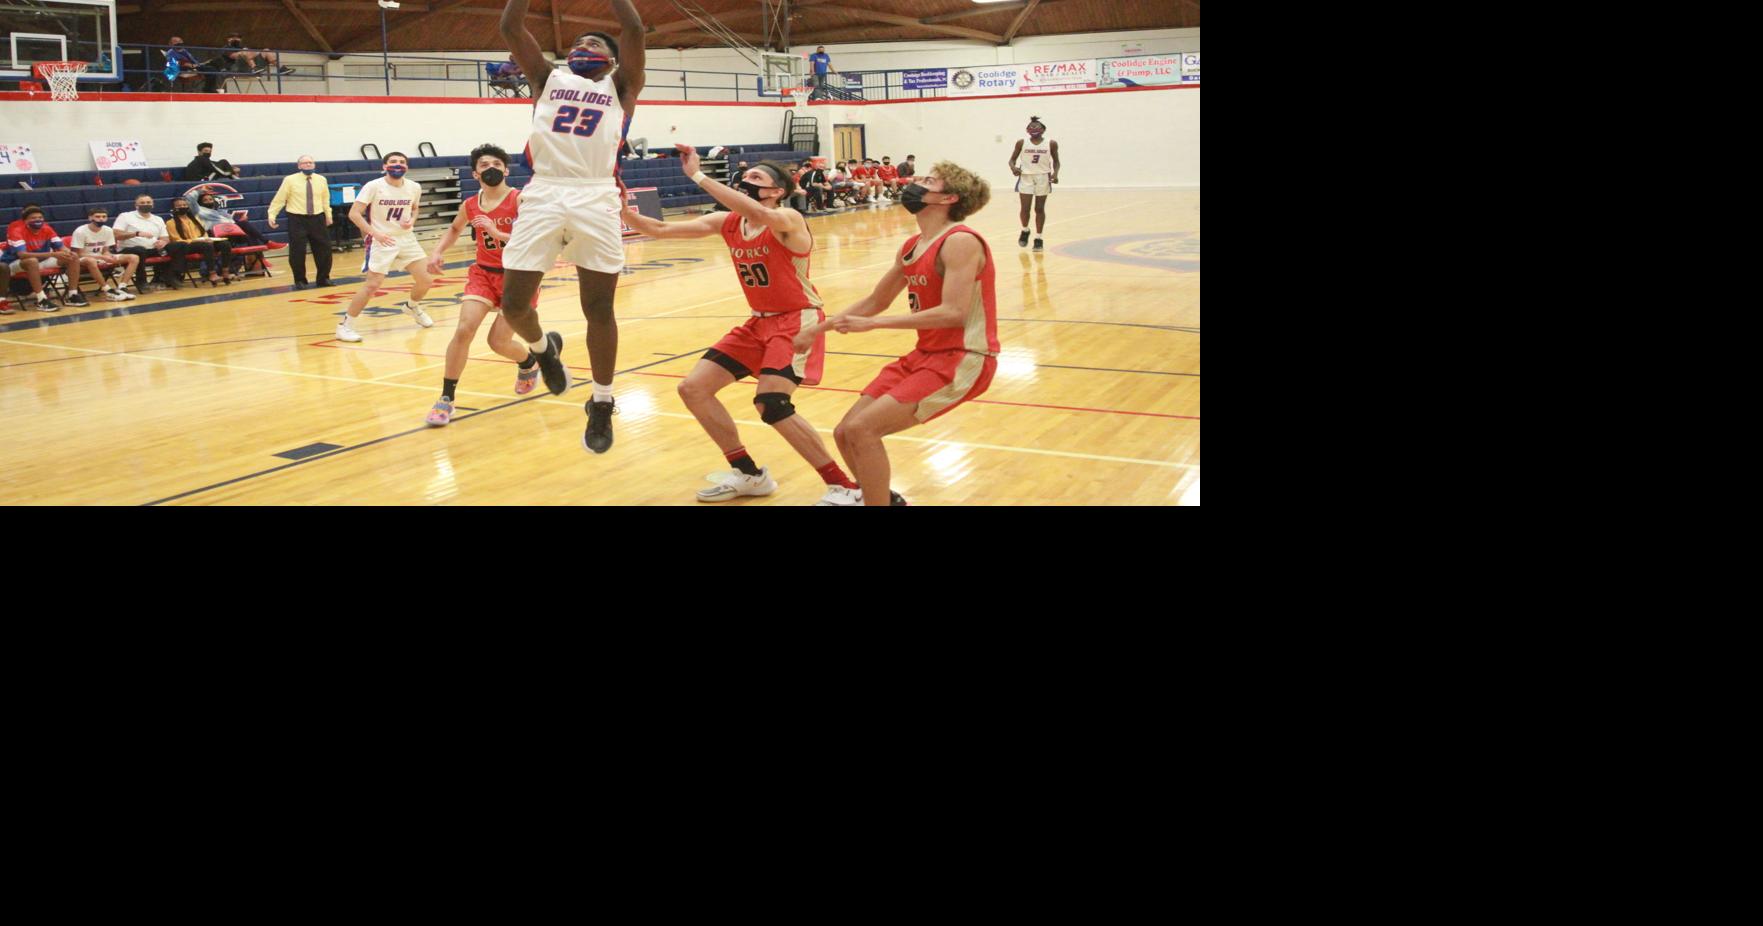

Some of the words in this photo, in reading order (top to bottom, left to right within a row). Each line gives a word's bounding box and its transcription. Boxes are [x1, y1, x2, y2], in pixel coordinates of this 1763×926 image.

[1034, 63, 1086, 74] RE/MAX
[1111, 60, 1146, 68] Coolidge
[1148, 57, 1177, 66] Engine
[978, 71, 1017, 79] Coolidge
[978, 79, 1016, 87] Rotary
[550, 89, 613, 106] COOLIDGE
[552, 104, 604, 137] 23
[107, 148, 127, 163] 30
[1031, 154, 1040, 164] 3
[386, 207, 404, 221] 14
[737, 262, 770, 288] 20
